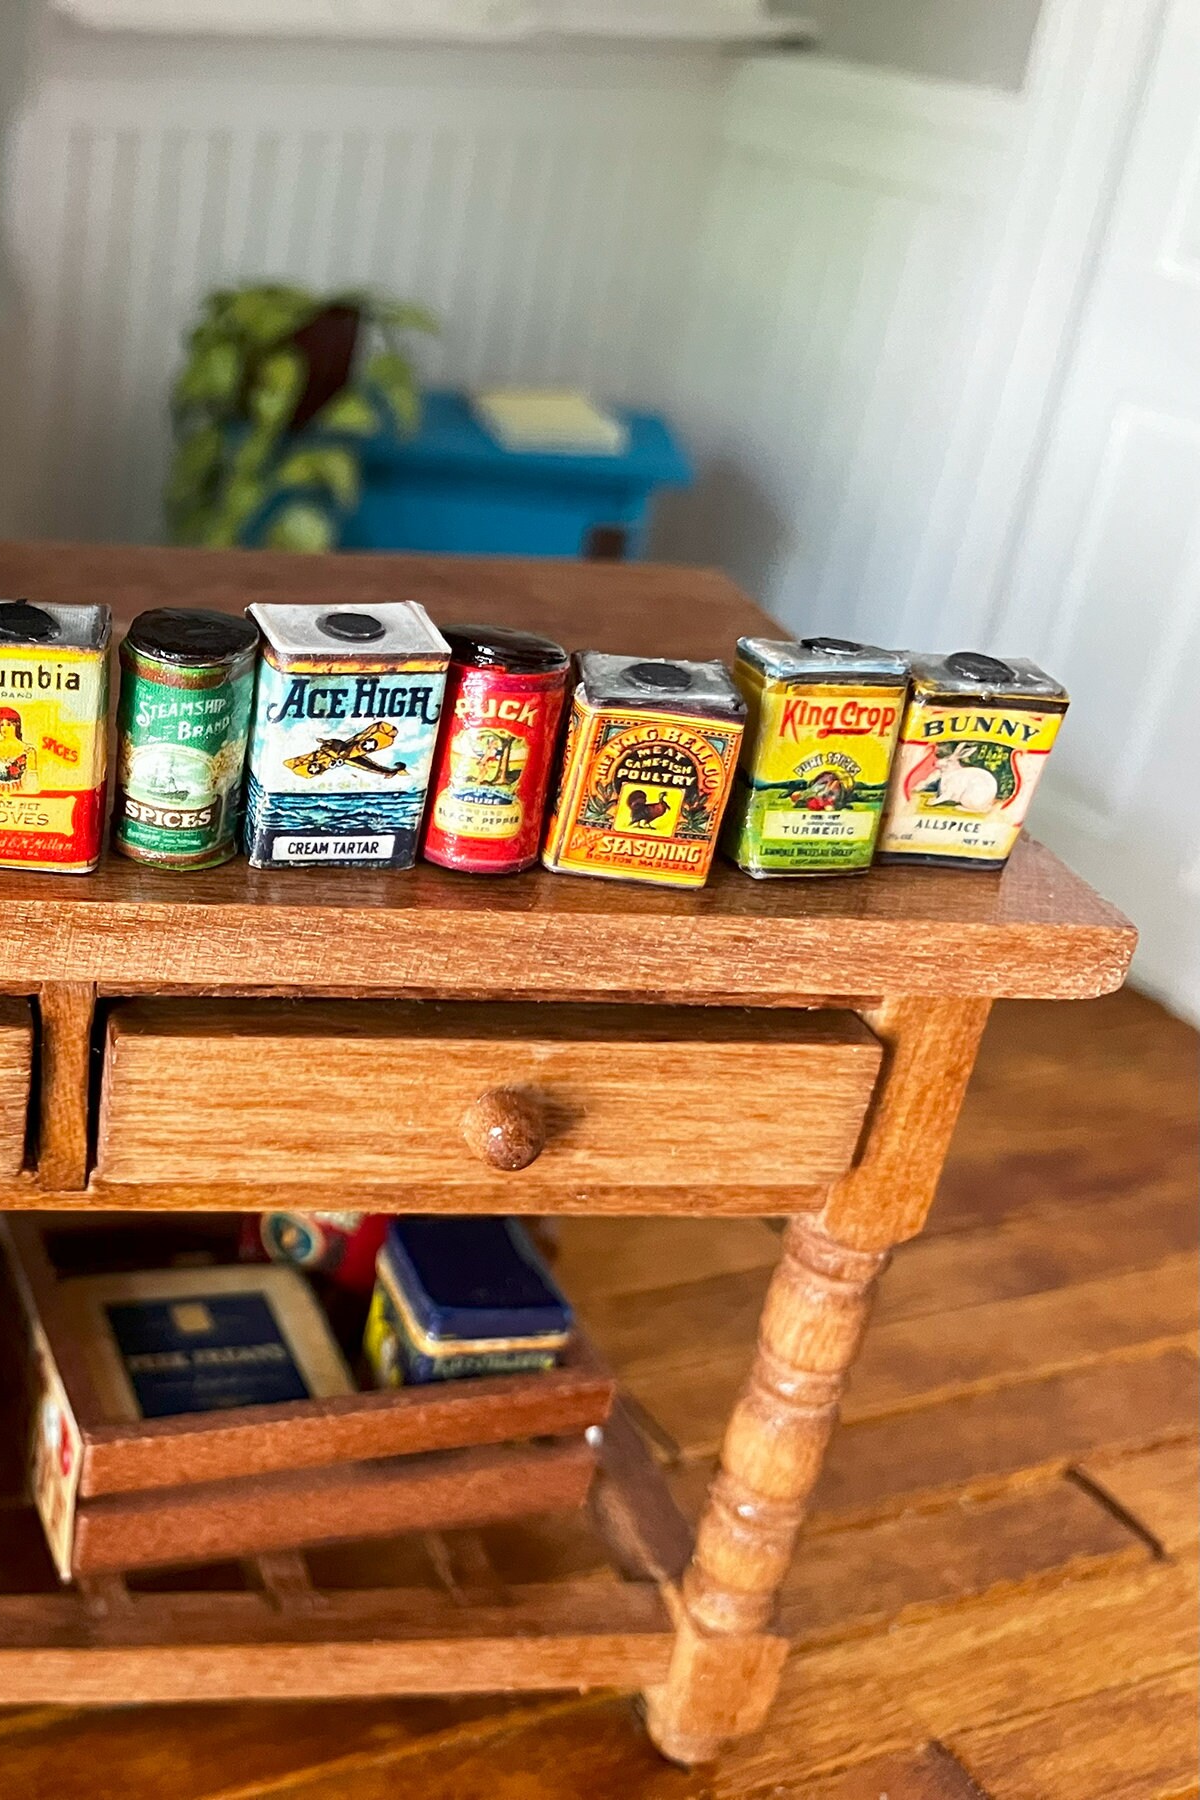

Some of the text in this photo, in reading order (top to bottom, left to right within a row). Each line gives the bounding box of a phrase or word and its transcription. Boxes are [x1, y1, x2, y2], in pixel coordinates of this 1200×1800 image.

[136, 699, 226, 727] STEAMSHIP
[267, 679, 441, 725] ACE HIGH
[178, 716, 230, 740] BRAND
[779, 700, 897, 744] King Crop
[924, 715, 1040, 743] BUNNY
[41, 736, 78, 763] SPICES
[637, 746, 686, 762] MEAT
[617, 768, 697, 786] POULTRY
[125, 800, 212, 828] SPICES
[915, 820, 982, 833] ALLSPICE
[783, 825, 855, 836] TURMERIC
[288, 841, 379, 855] CREAM TARTAR
[600, 835, 701, 863] SEASONING
